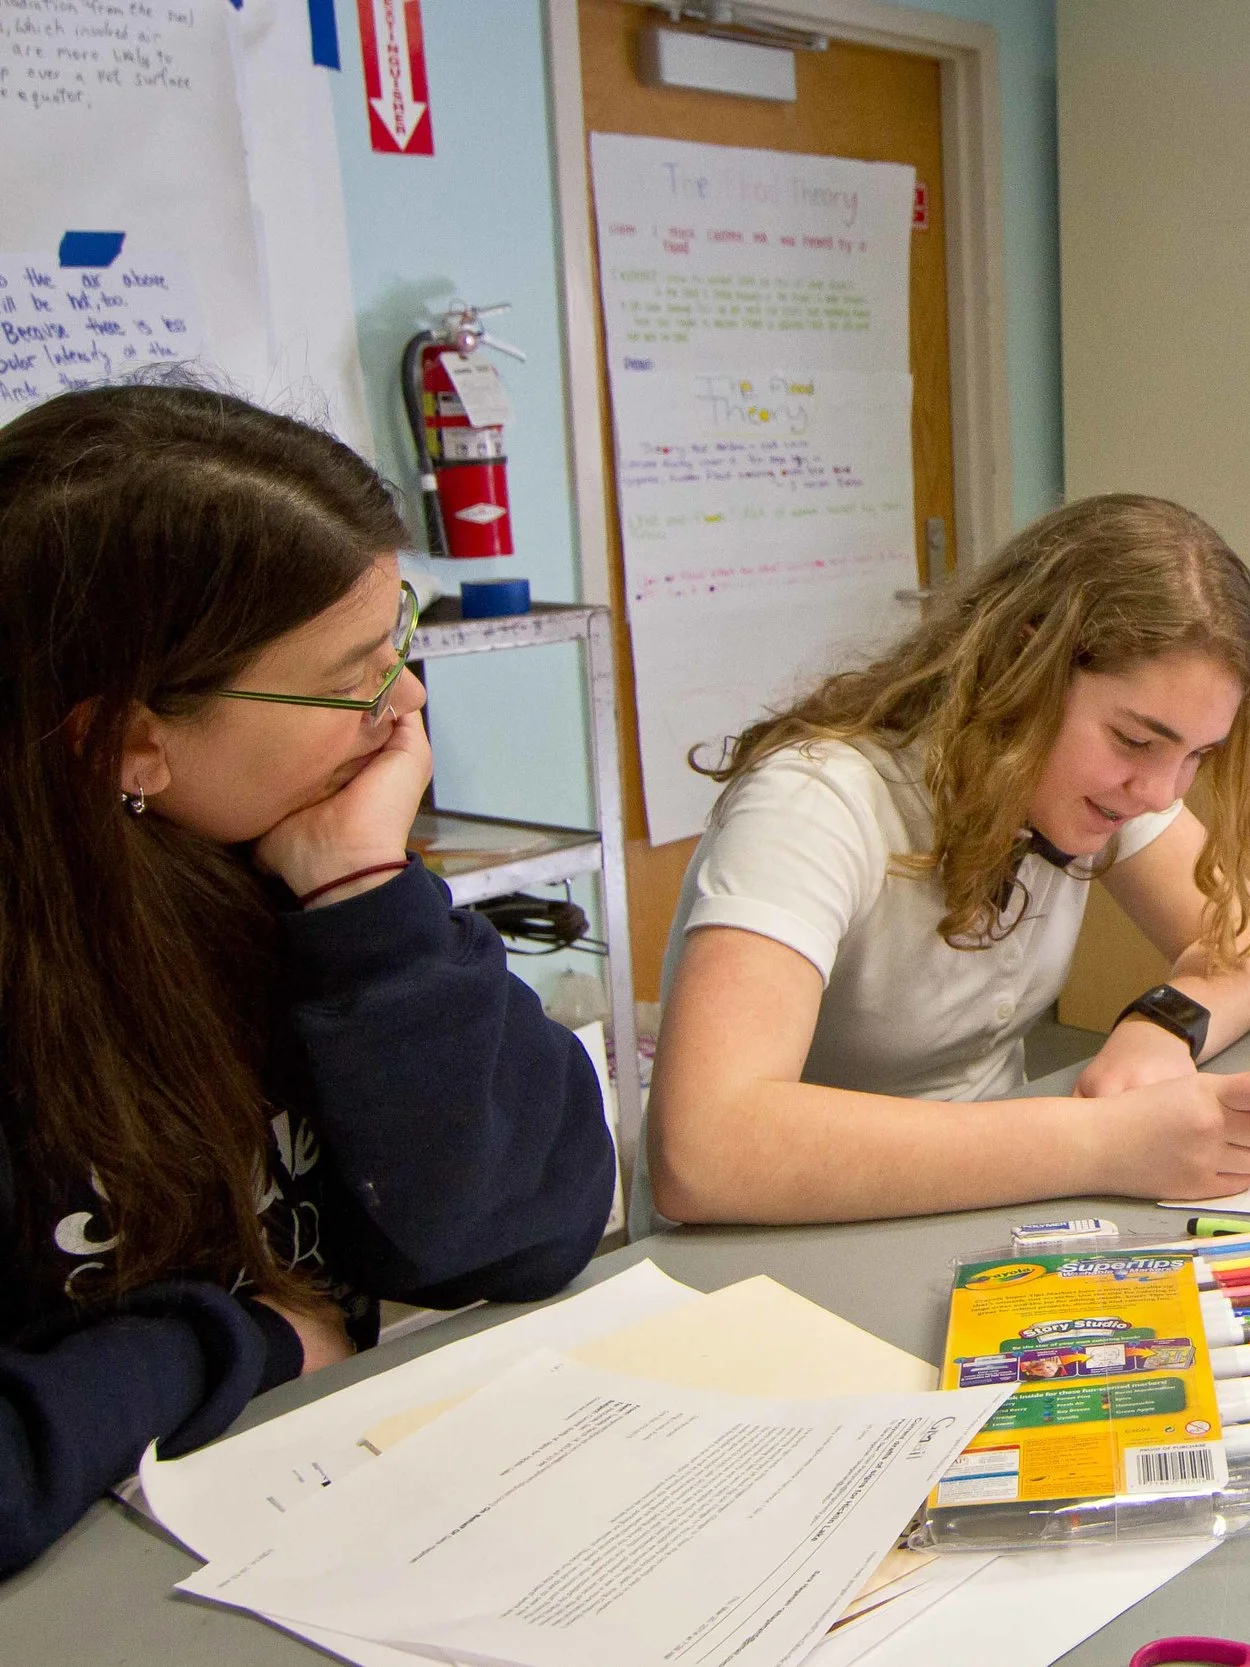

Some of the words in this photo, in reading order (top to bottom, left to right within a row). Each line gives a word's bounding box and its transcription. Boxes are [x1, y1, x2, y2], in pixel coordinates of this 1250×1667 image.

[25, 267, 56, 290] the
[31, 292, 52, 312] be
[0, 321, 70, 346] Because
[1023, 1322, 1069, 1338] Story
[1074, 1320, 1128, 1329] Studio
[1131, 1380, 1168, 1388] markers!
[811, 1526, 828, 1541] Lake
